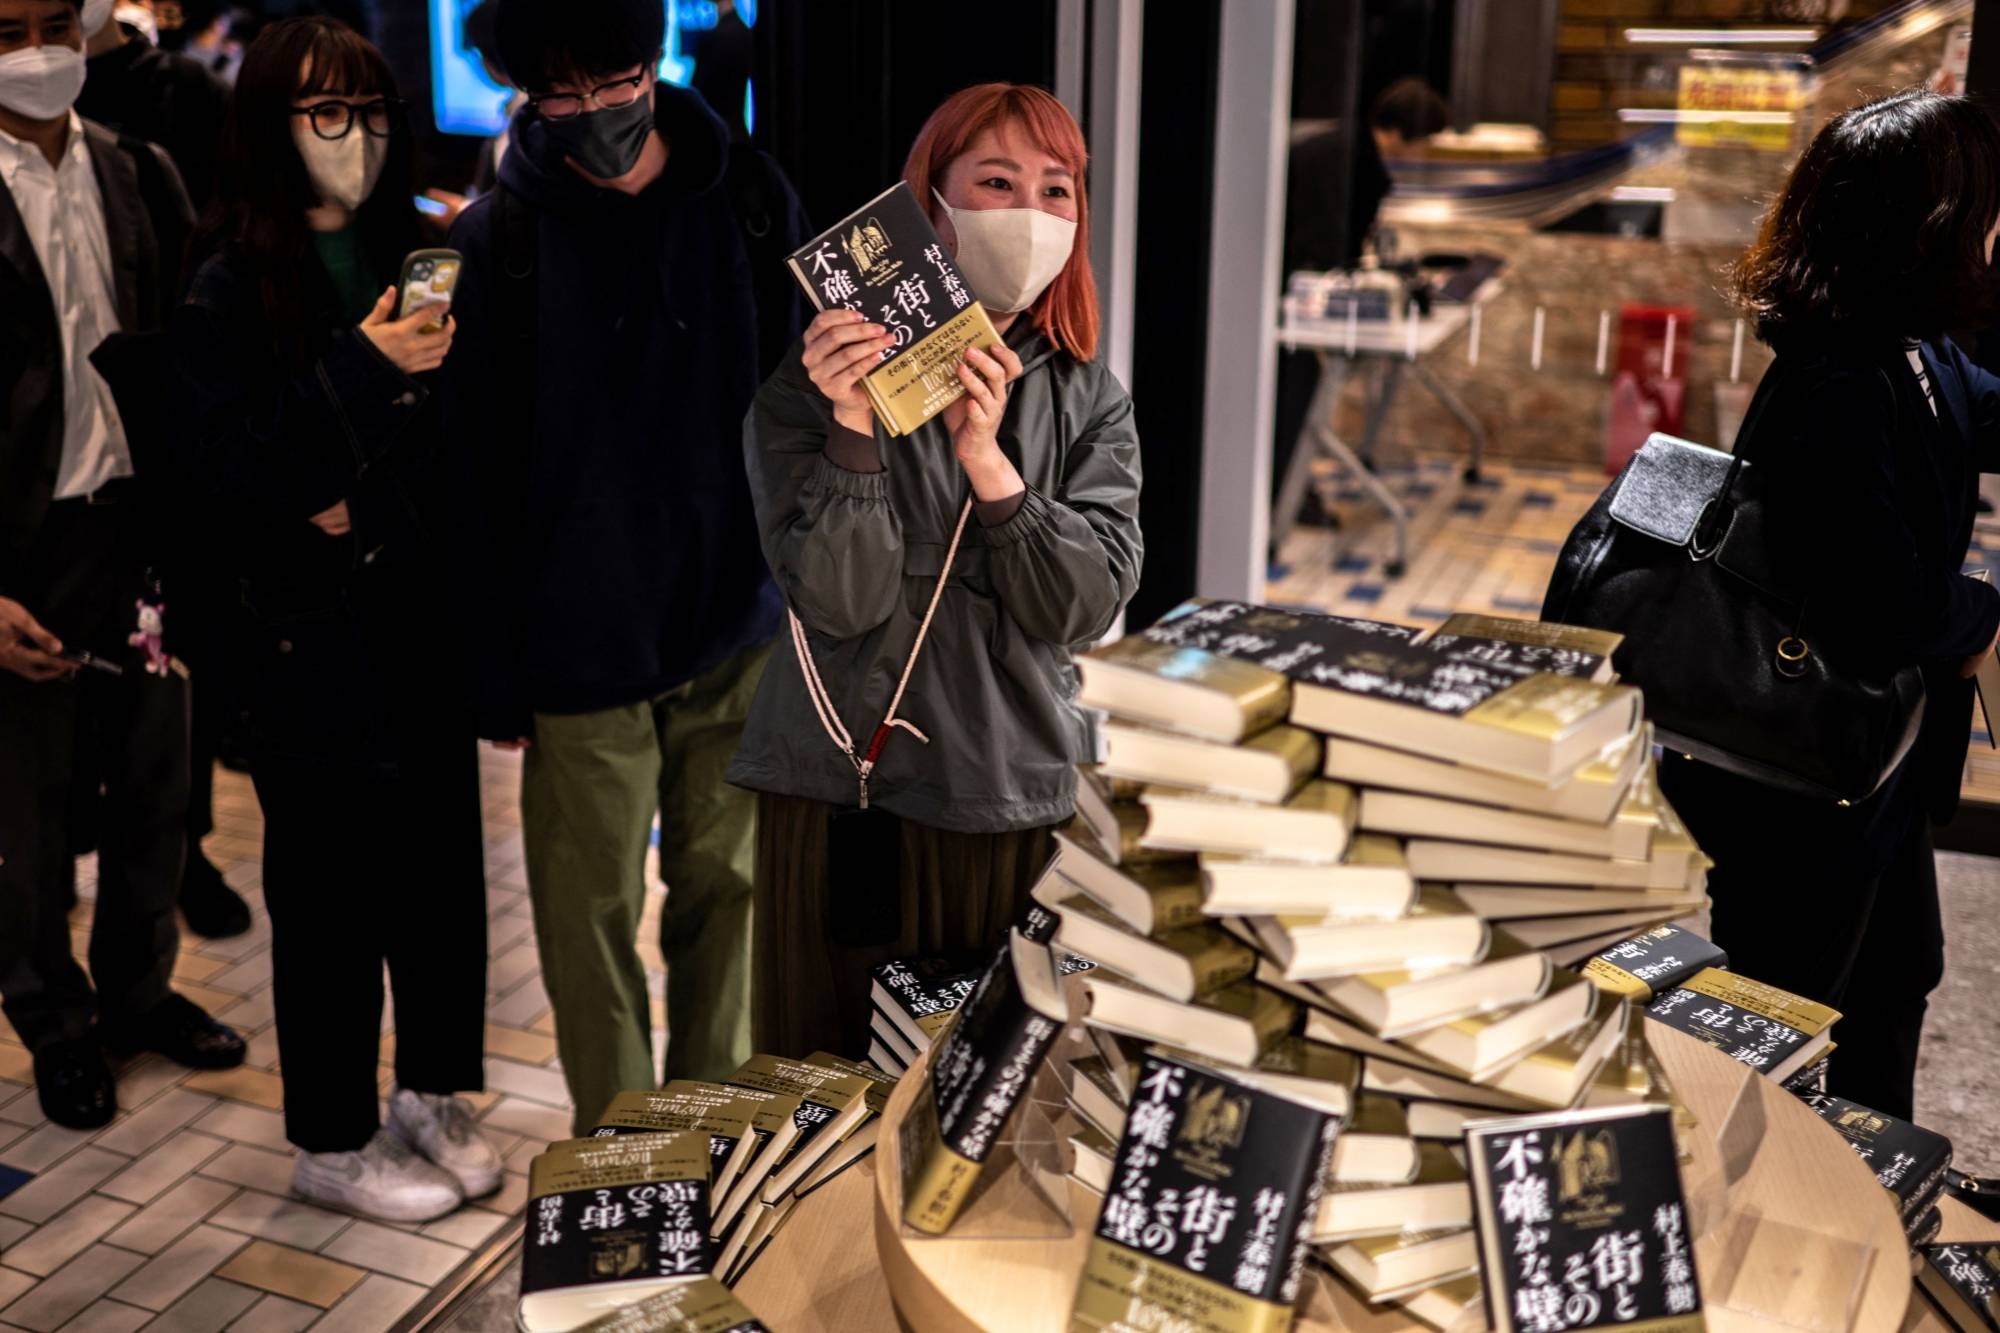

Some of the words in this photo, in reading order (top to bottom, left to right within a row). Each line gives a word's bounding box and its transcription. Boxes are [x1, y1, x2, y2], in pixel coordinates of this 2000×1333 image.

[893, 273, 936, 329] 街と
[923, 243, 970, 309] 村上春樹
[880, 305, 913, 346] その
[876, 961, 946, 1017] 不確かな壁
[1651, 988, 1697, 1016] 村上春樹
[1688, 1003, 1734, 1028] 街と
[1736, 1014, 1769, 1034] その
[1102, 1060, 1186, 1249] 不確かな壁
[536, 1194, 564, 1247] 村上春樹
[579, 1189, 627, 1231] 街と
[627, 1185, 658, 1219] その
[658, 1181, 703, 1276] 不確かな壁
[1141, 1187, 1180, 1256] その
[1180, 1185, 1238, 1272] 街と
[1493, 1131, 1567, 1332] 不確かな壁
[1233, 1186, 1286, 1295] 村上春樹
[1652, 1201, 1696, 1315] 村上春樹
[1563, 1251, 1602, 1326] その
[1588, 1229, 1645, 1322] 街と
[1936, 1245, 1995, 1303] 不確か
